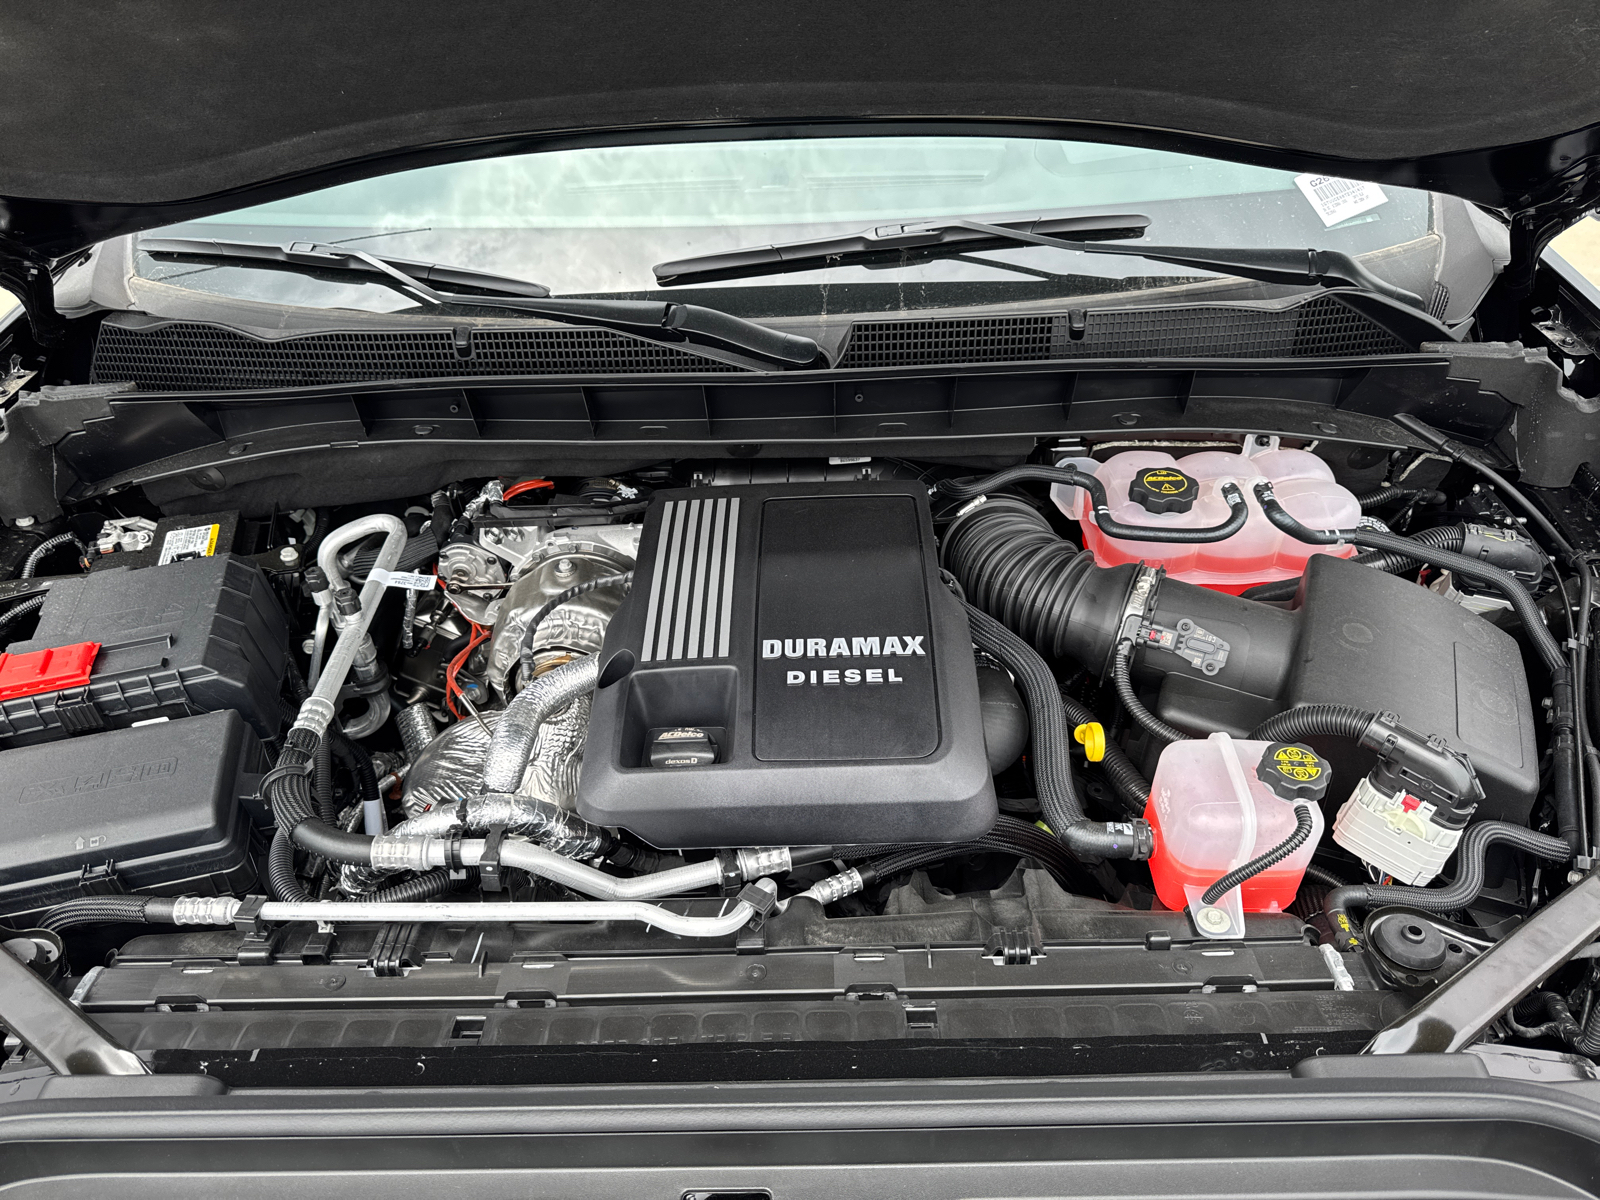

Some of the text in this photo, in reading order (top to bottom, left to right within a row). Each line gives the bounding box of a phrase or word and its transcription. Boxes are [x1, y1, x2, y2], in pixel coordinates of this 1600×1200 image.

[762, 635, 926, 659] DURAMAX
[787, 668, 903, 686] DIESEL
[658, 731, 705, 740] ACDelco
